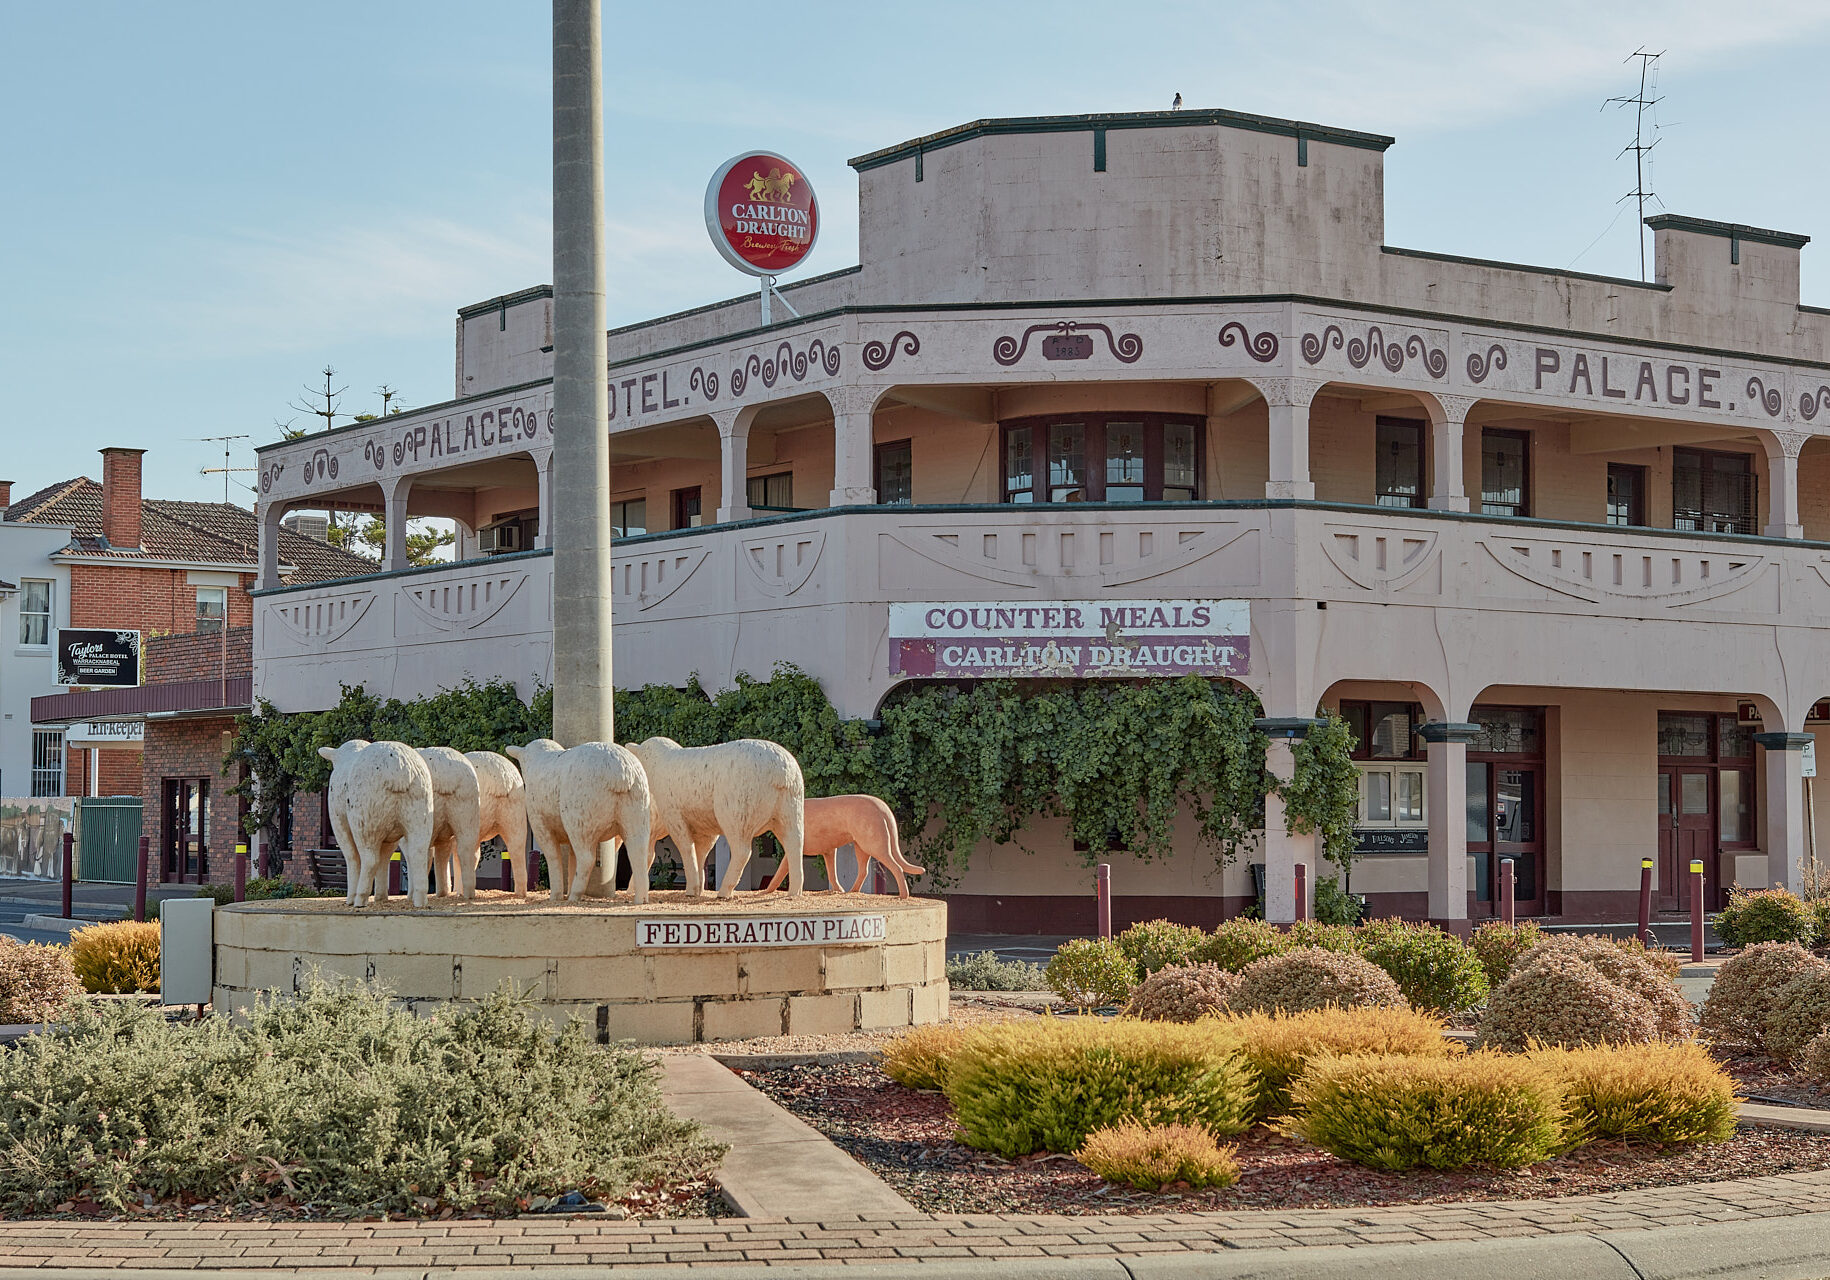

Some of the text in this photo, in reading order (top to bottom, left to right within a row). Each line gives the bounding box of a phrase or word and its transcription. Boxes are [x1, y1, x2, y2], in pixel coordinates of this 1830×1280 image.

[731, 203, 808, 225] CARLTON
[736, 220, 806, 239] DRAUGHT
[608, 370, 689, 421] OTEL.
[925, 606, 1211, 630] COUNTER MEALS
[68, 642, 104, 660] Taylors
[942, 645, 1236, 668] CARLTON DRAUGHT
[644, 917, 883, 945] FEDERATION PLACE
